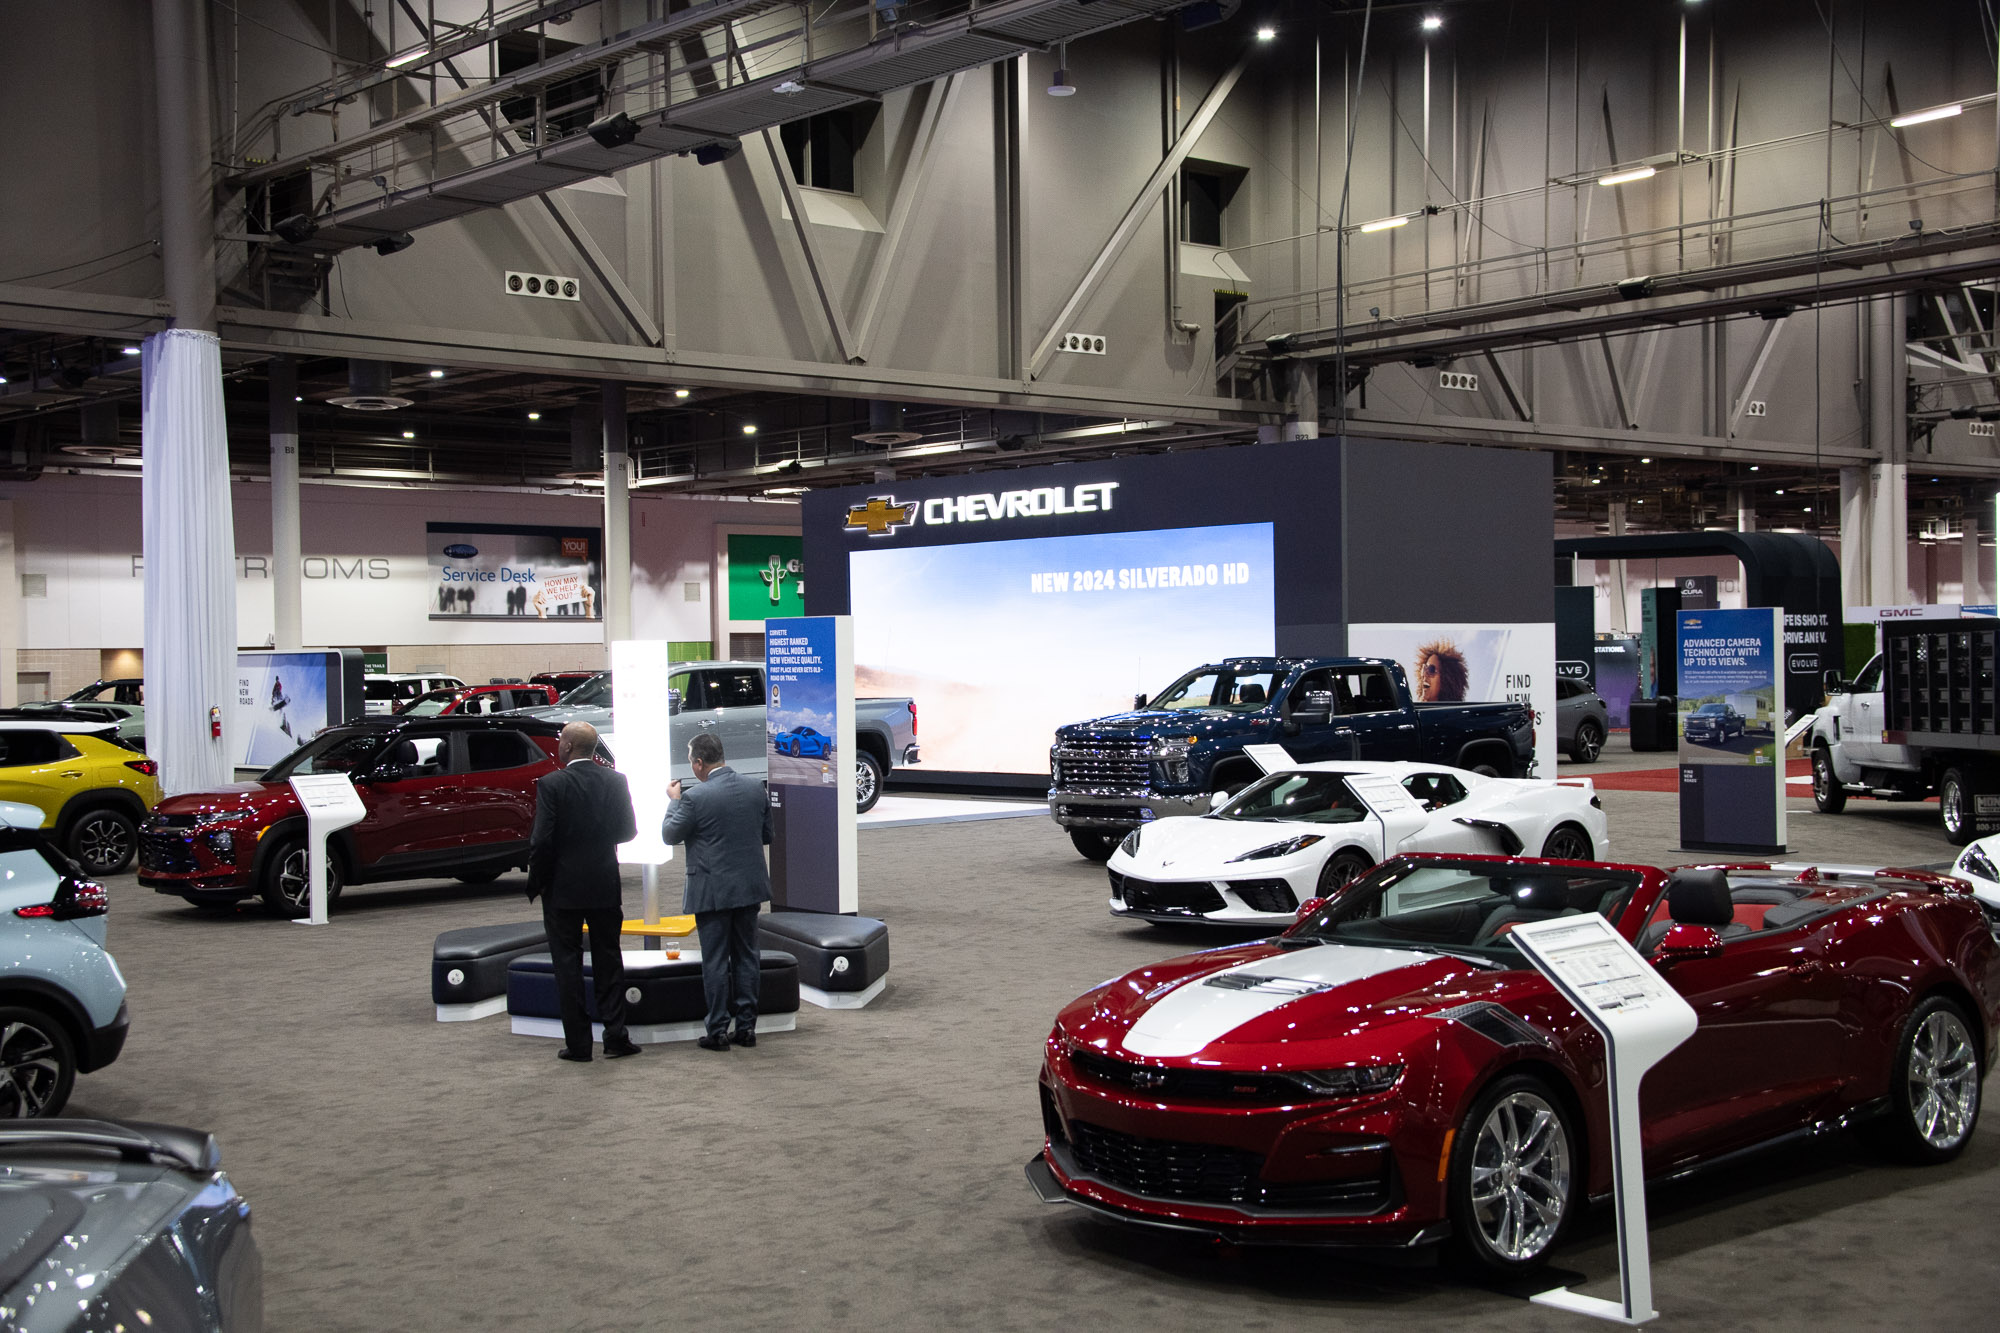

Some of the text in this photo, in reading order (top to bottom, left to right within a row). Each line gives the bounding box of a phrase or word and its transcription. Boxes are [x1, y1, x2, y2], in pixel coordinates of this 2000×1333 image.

[924, 481, 1120, 526] CHEVROLET
[564, 541, 586, 551] YOU!
[442, 566, 536, 583] Service Desk
[1031, 562, 1250, 594] NEW 2024 SILVERADO HD
[544, 576, 578, 588] HOW MAY
[546, 584, 578, 594] WE HELP
[554, 592, 573, 600] YOU?
[1880, 608, 1923, 618] GMC
[1784, 614, 1794, 626] IFE
[770, 637, 808, 646] HIGHEST RANKED
[1683, 638, 1761, 648] ADVANCED CAMERA
[1783, 632, 1804, 644] DRIVE
[770, 646, 813, 656] OVERALL MODEL IN
[1684, 648, 1760, 657] TECHNOLOGY WITH
[770, 656, 822, 665] NEW VEHICLE QUALITY.
[1684, 657, 1748, 666] UP TO 15 VIEWS.
[1792, 660, 1818, 668] EVOLVE
[239, 679, 249, 687] FIND
[1506, 674, 1531, 688] FIND
